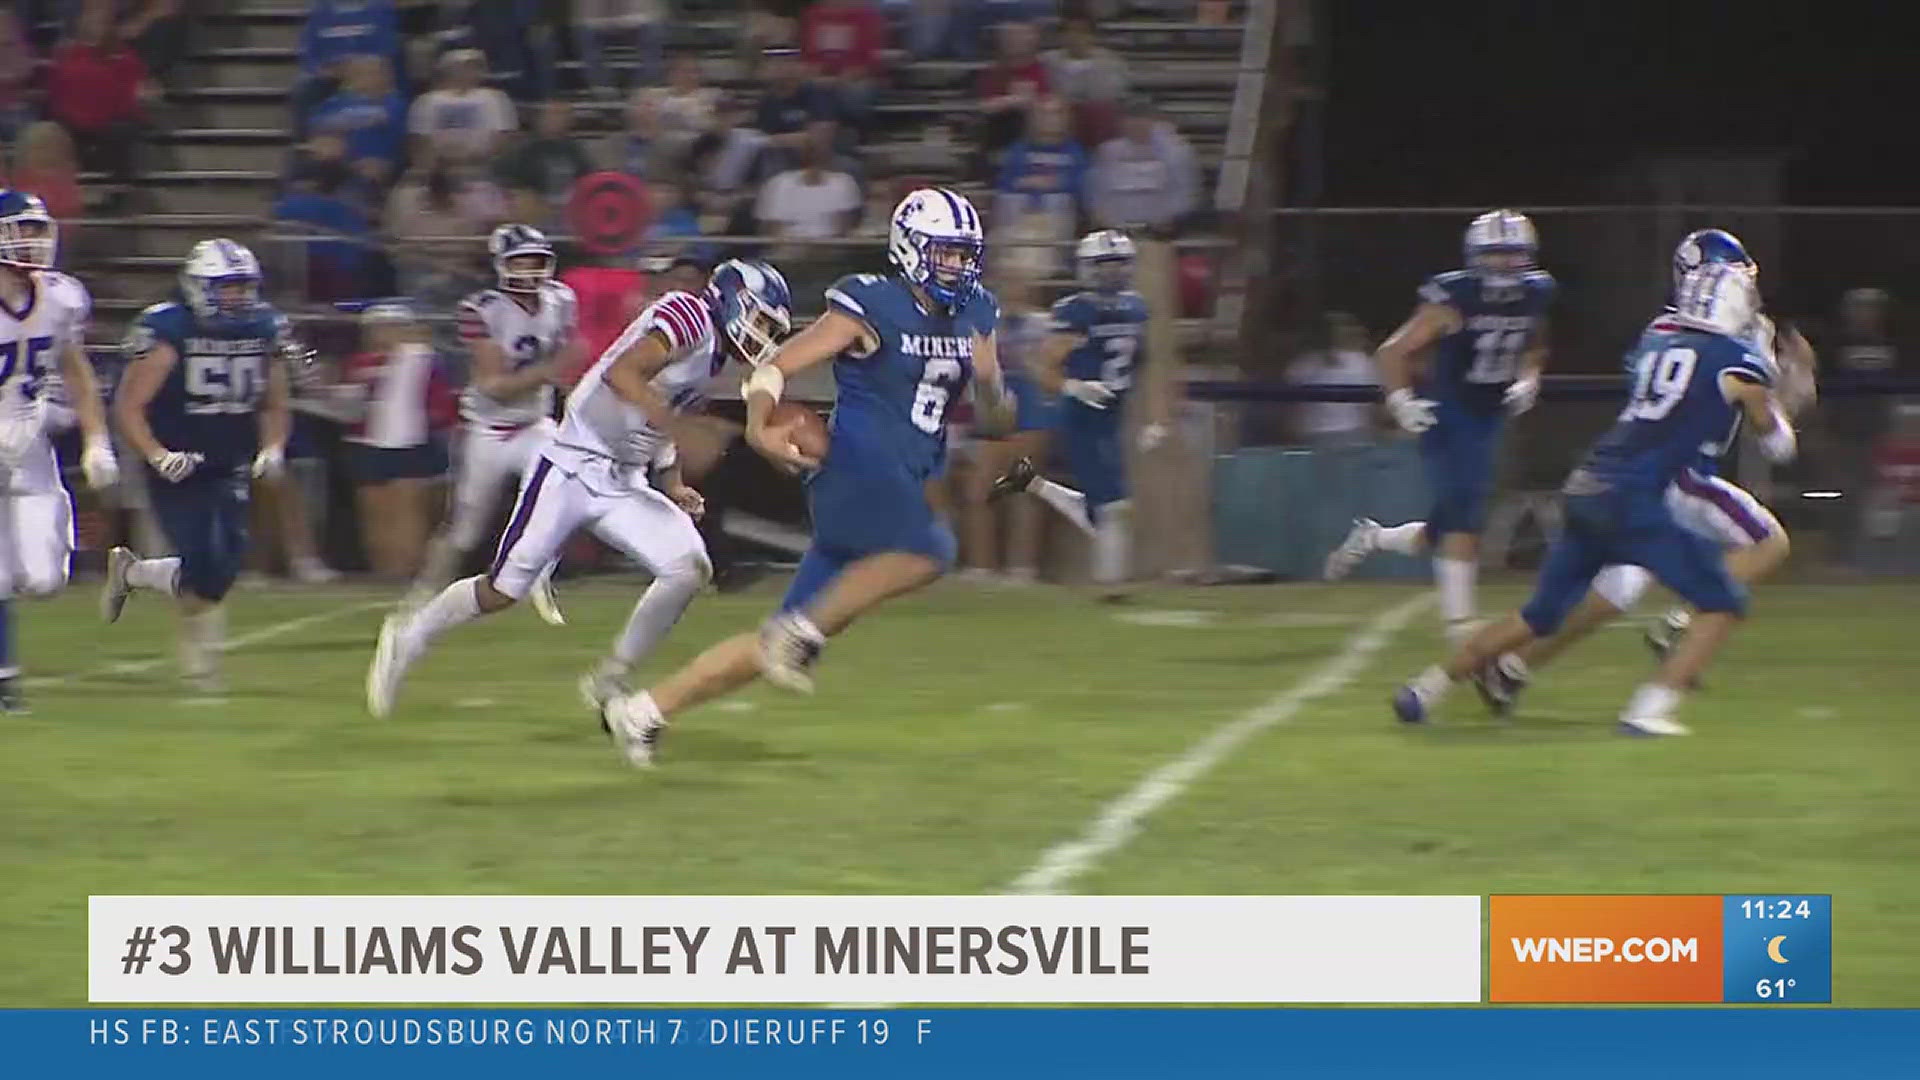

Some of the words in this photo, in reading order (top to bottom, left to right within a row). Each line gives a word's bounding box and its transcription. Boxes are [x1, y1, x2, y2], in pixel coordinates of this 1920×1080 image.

[183, 356, 267, 415] 50
[910, 357, 963, 434] 6
[1617, 348, 1697, 421] 19
